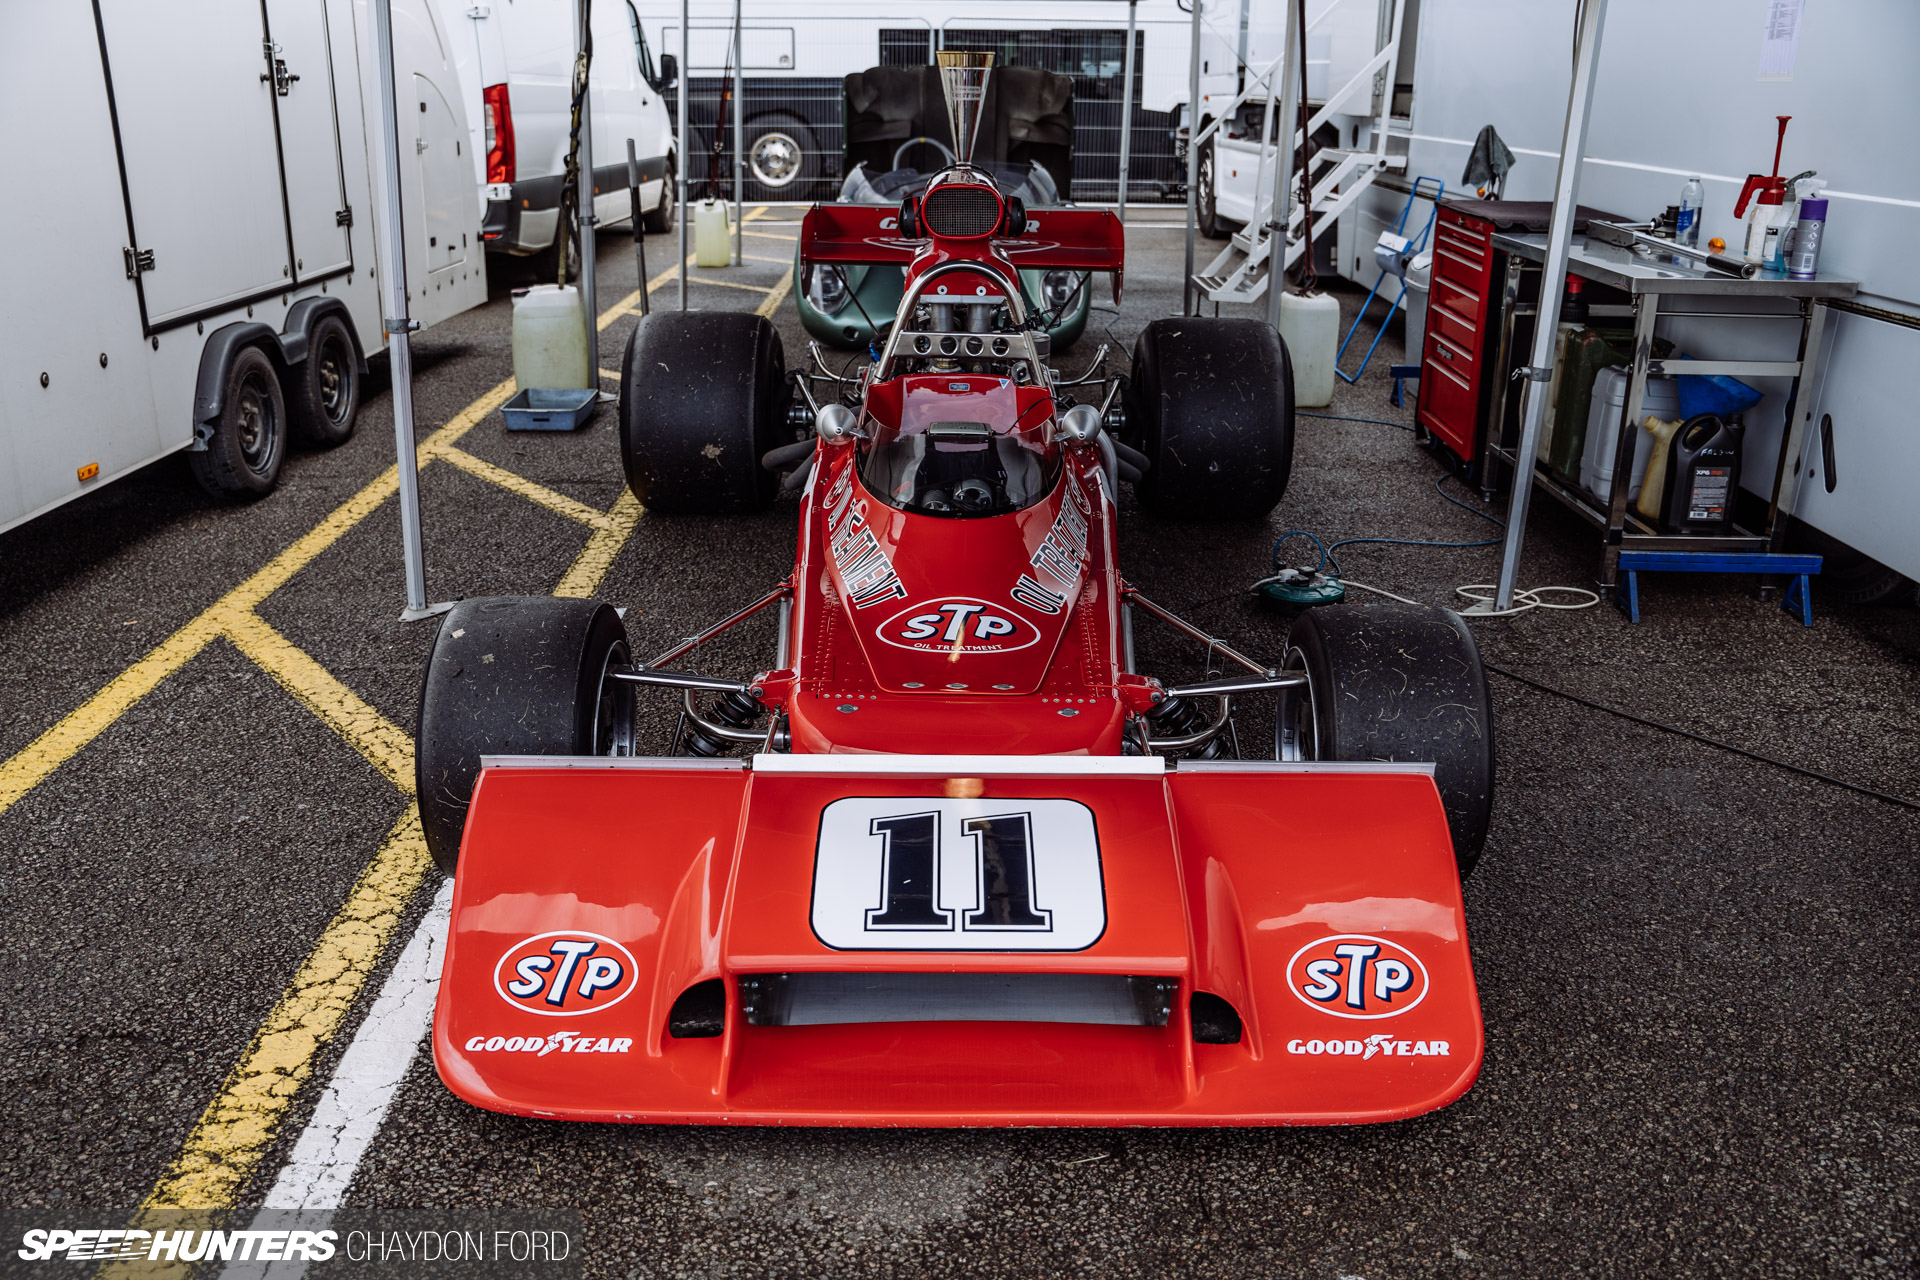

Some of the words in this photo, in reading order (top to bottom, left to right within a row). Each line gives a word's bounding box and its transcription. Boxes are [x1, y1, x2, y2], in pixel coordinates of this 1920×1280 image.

[1029, 483, 1088, 589] TREATMENT
[900, 603, 1017, 642] STP
[1010, 573, 1067, 615] OIL
[864, 810, 1053, 932] 11
[507, 940, 624, 1007] STP
[1303, 943, 1414, 1010] STP
